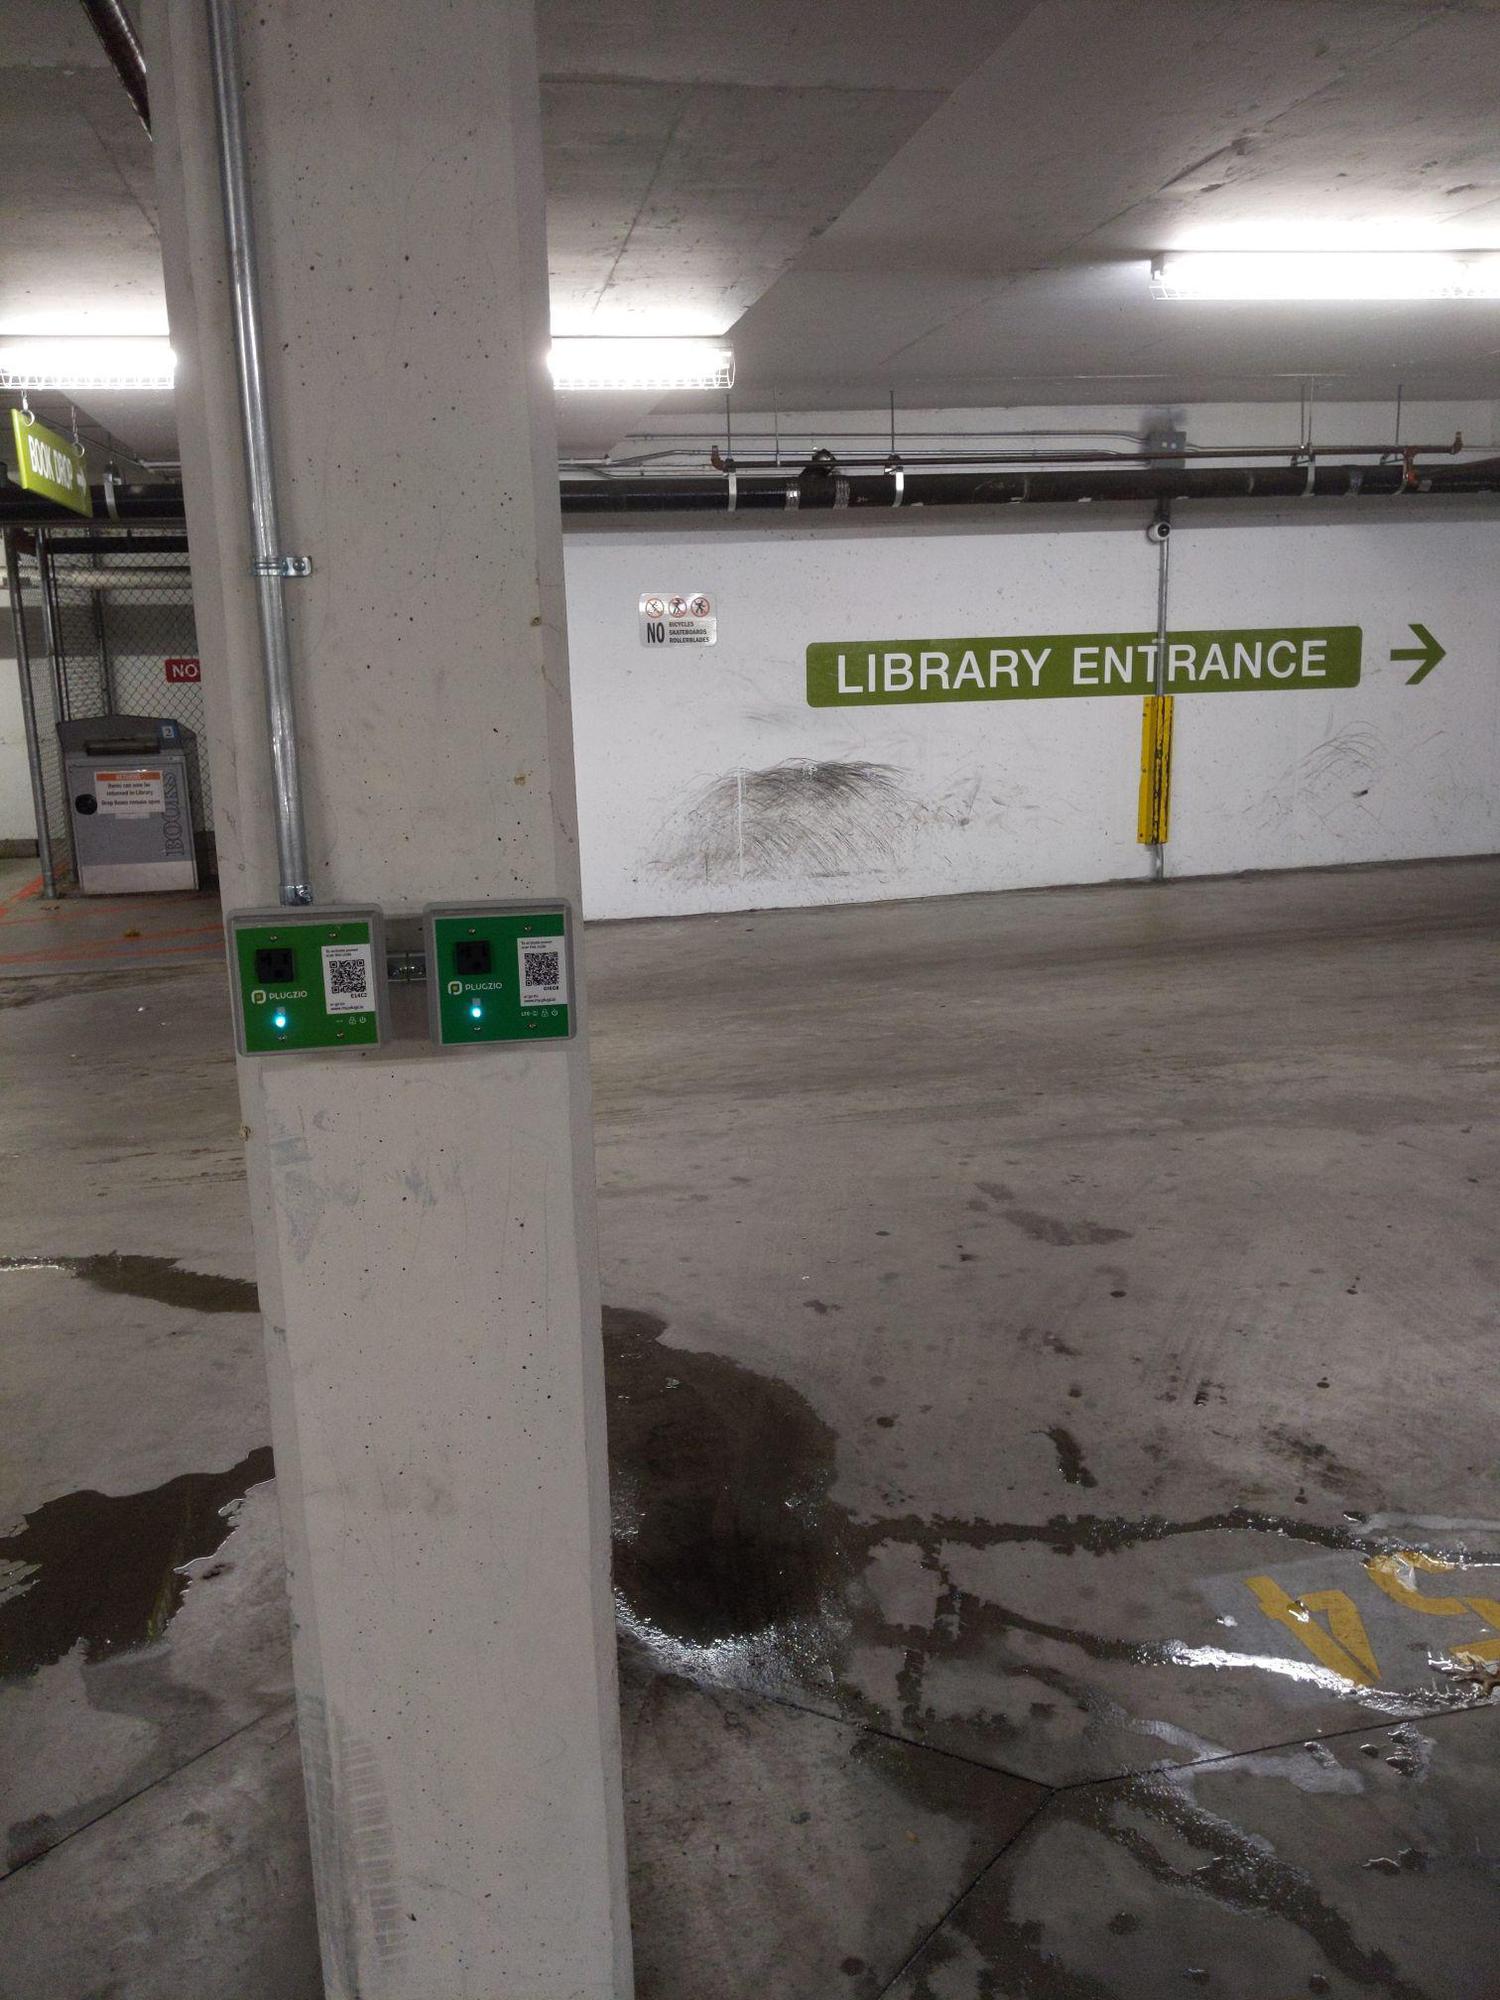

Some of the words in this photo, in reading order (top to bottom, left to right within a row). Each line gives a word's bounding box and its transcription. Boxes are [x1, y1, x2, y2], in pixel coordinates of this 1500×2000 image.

[28, 434, 55, 482] BOOK
[53, 449, 73, 491] DROP
[646, 622, 665, 643] NO
[172, 664, 198, 678] NO
[837, 648, 1052, 694] LIBRARY
[1072, 639, 1328, 685] ENTRANCE
[164, 726, 173, 738] 2
[163, 771, 184, 856] BOOKS
[269, 990, 308, 1000] PLUGZIO
[465, 982, 503, 991] PLUGZIO
